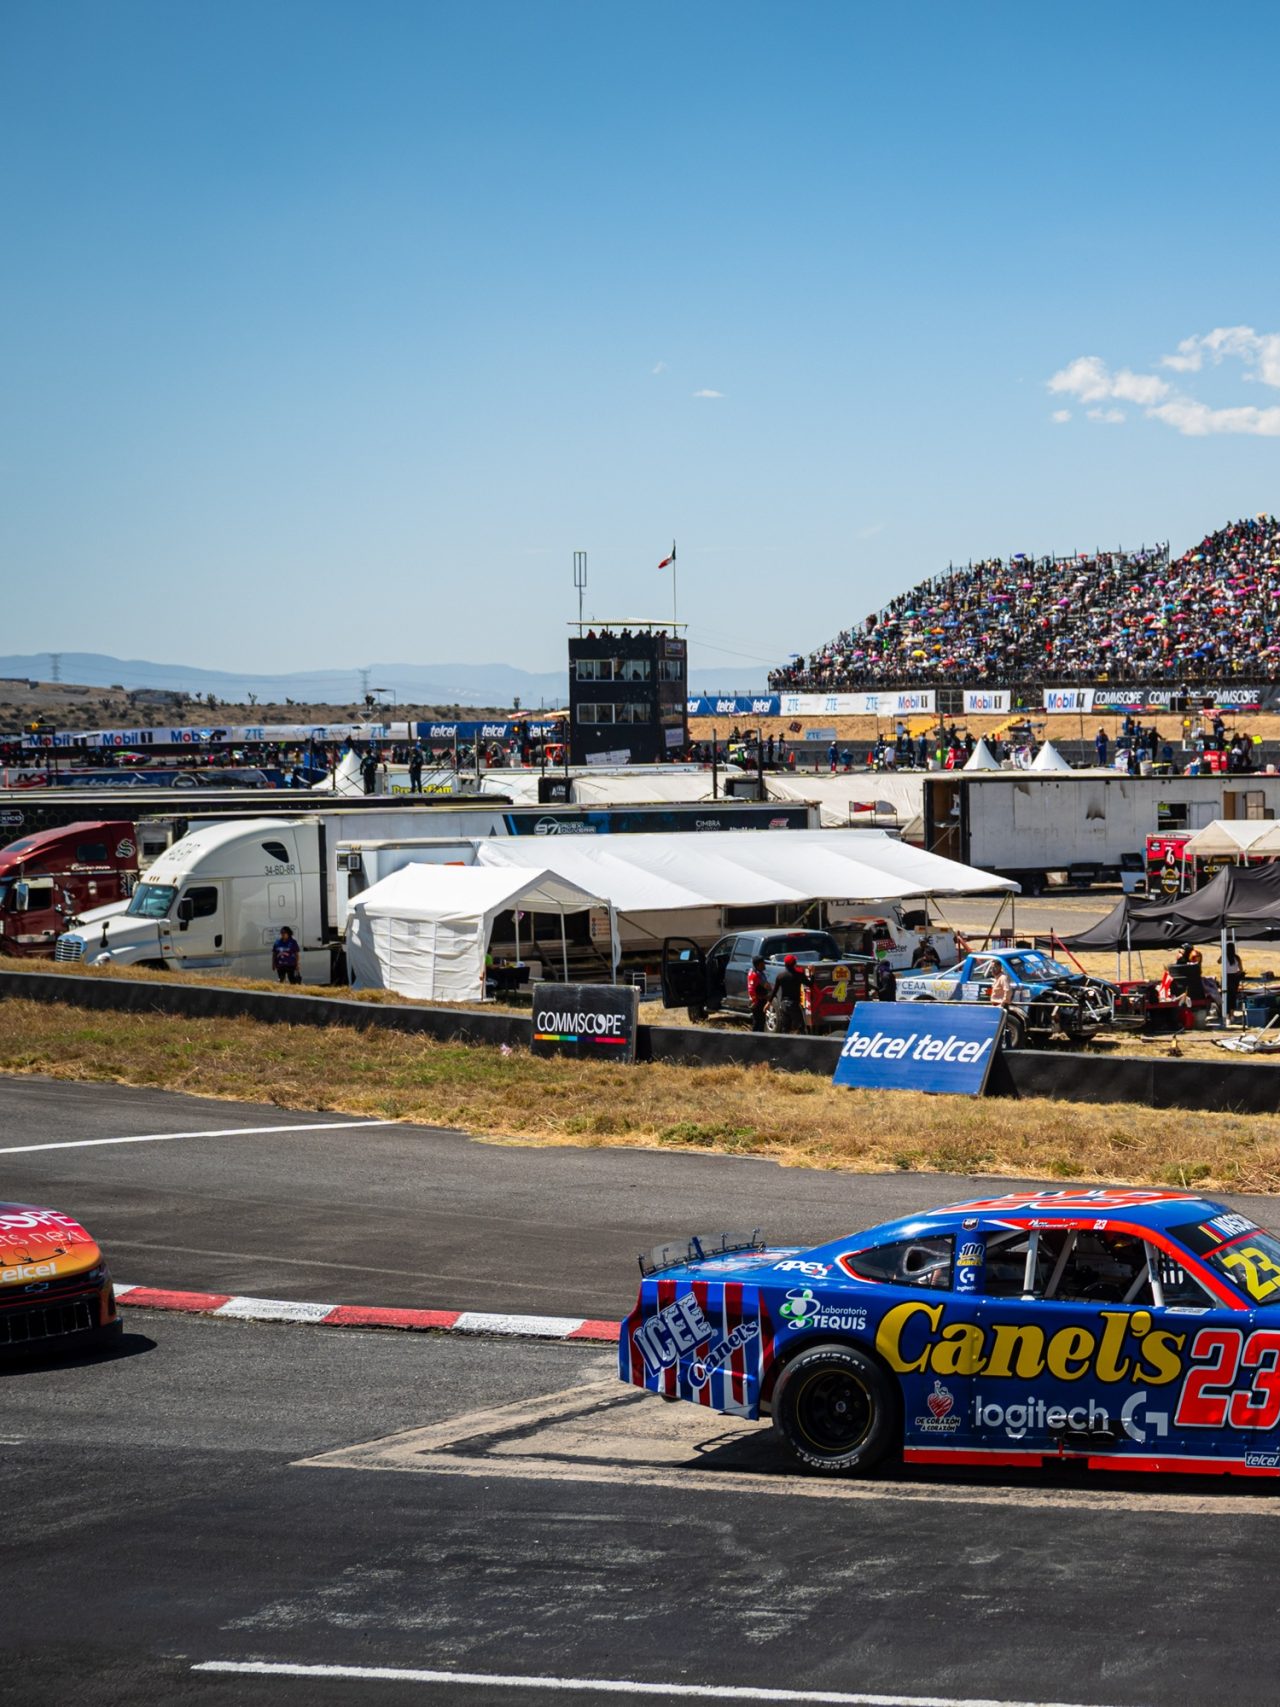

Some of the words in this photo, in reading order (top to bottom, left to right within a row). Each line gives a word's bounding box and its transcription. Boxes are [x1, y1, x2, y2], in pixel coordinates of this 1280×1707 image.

[825, 698, 838, 711] ZTE
[866, 697, 879, 710] ZTE
[898, 696, 920, 708] Mobil
[970, 696, 992, 709] Mobil
[994, 695, 1002, 709] 1
[1049, 693, 1074, 708] Mobil
[1095, 692, 1143, 704] COMMSCOPE
[717, 699, 736, 712] telcel
[753, 699, 772, 712] telcel
[787, 698, 800, 712] ZTE
[245, 729, 264, 740] ZTE
[371, 727, 388, 738] ZTE
[430, 725, 457, 737] telcel
[482, 725, 507, 737] telcel
[806, 732, 821, 740] ZTE
[103, 732, 138, 745] Mobil
[141, 731, 153, 744] 1
[901, 980, 927, 990] CEAA
[537, 1011, 622, 1034] COMMSCOPE
[841, 1031, 917, 1059] telcel
[912, 1034, 993, 1063] telcel
[1093, 1219, 1108, 1230] 23
[29, 1230, 90, 1244] next
[962, 1243, 985, 1256] 100
[0, 1262, 57, 1283] elcel
[773, 1260, 833, 1276] APEX
[821, 1305, 868, 1316] Laboratorio
[812, 1315, 867, 1331] TEQUIS
[633, 1291, 714, 1378] ICEE
[875, 1301, 1187, 1386] Canel's
[687, 1320, 760, 1390] Canel's
[915, 1416, 925, 1425] DE
[926, 1415, 961, 1426] CORAZÓN
[976, 1395, 1110, 1439] logitech
[1246, 1453, 1279, 1467] telcel
